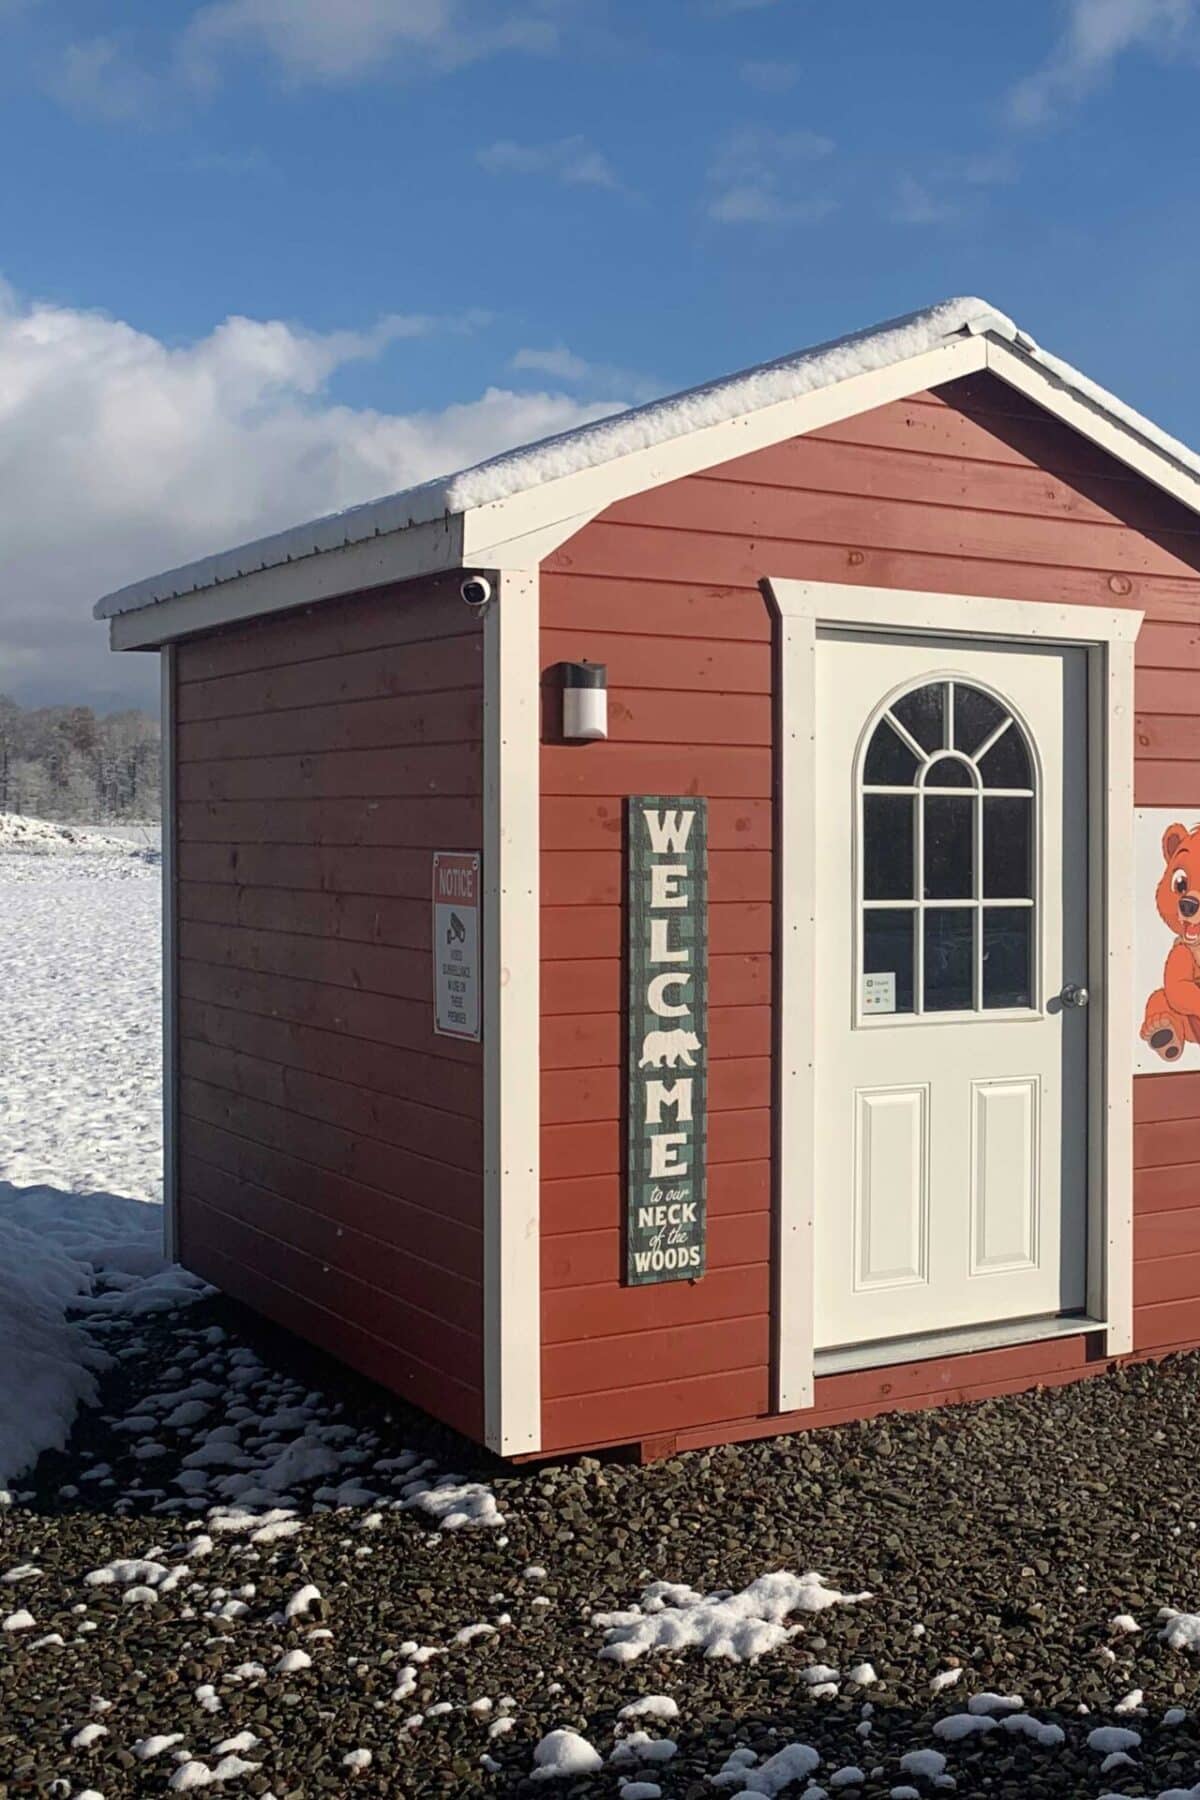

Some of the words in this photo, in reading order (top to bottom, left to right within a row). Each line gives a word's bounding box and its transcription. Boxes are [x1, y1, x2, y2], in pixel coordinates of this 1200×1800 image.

[439, 868, 473, 898] NOTICE
[642, 809, 700, 1178] WELCME
[650, 1184, 663, 1203] to
[665, 1188, 689, 1201] our
[638, 1202, 697, 1228] NECK
[648, 1224, 665, 1252] of
[667, 1224, 688, 1244] the
[634, 1246, 700, 1272] WOODS
